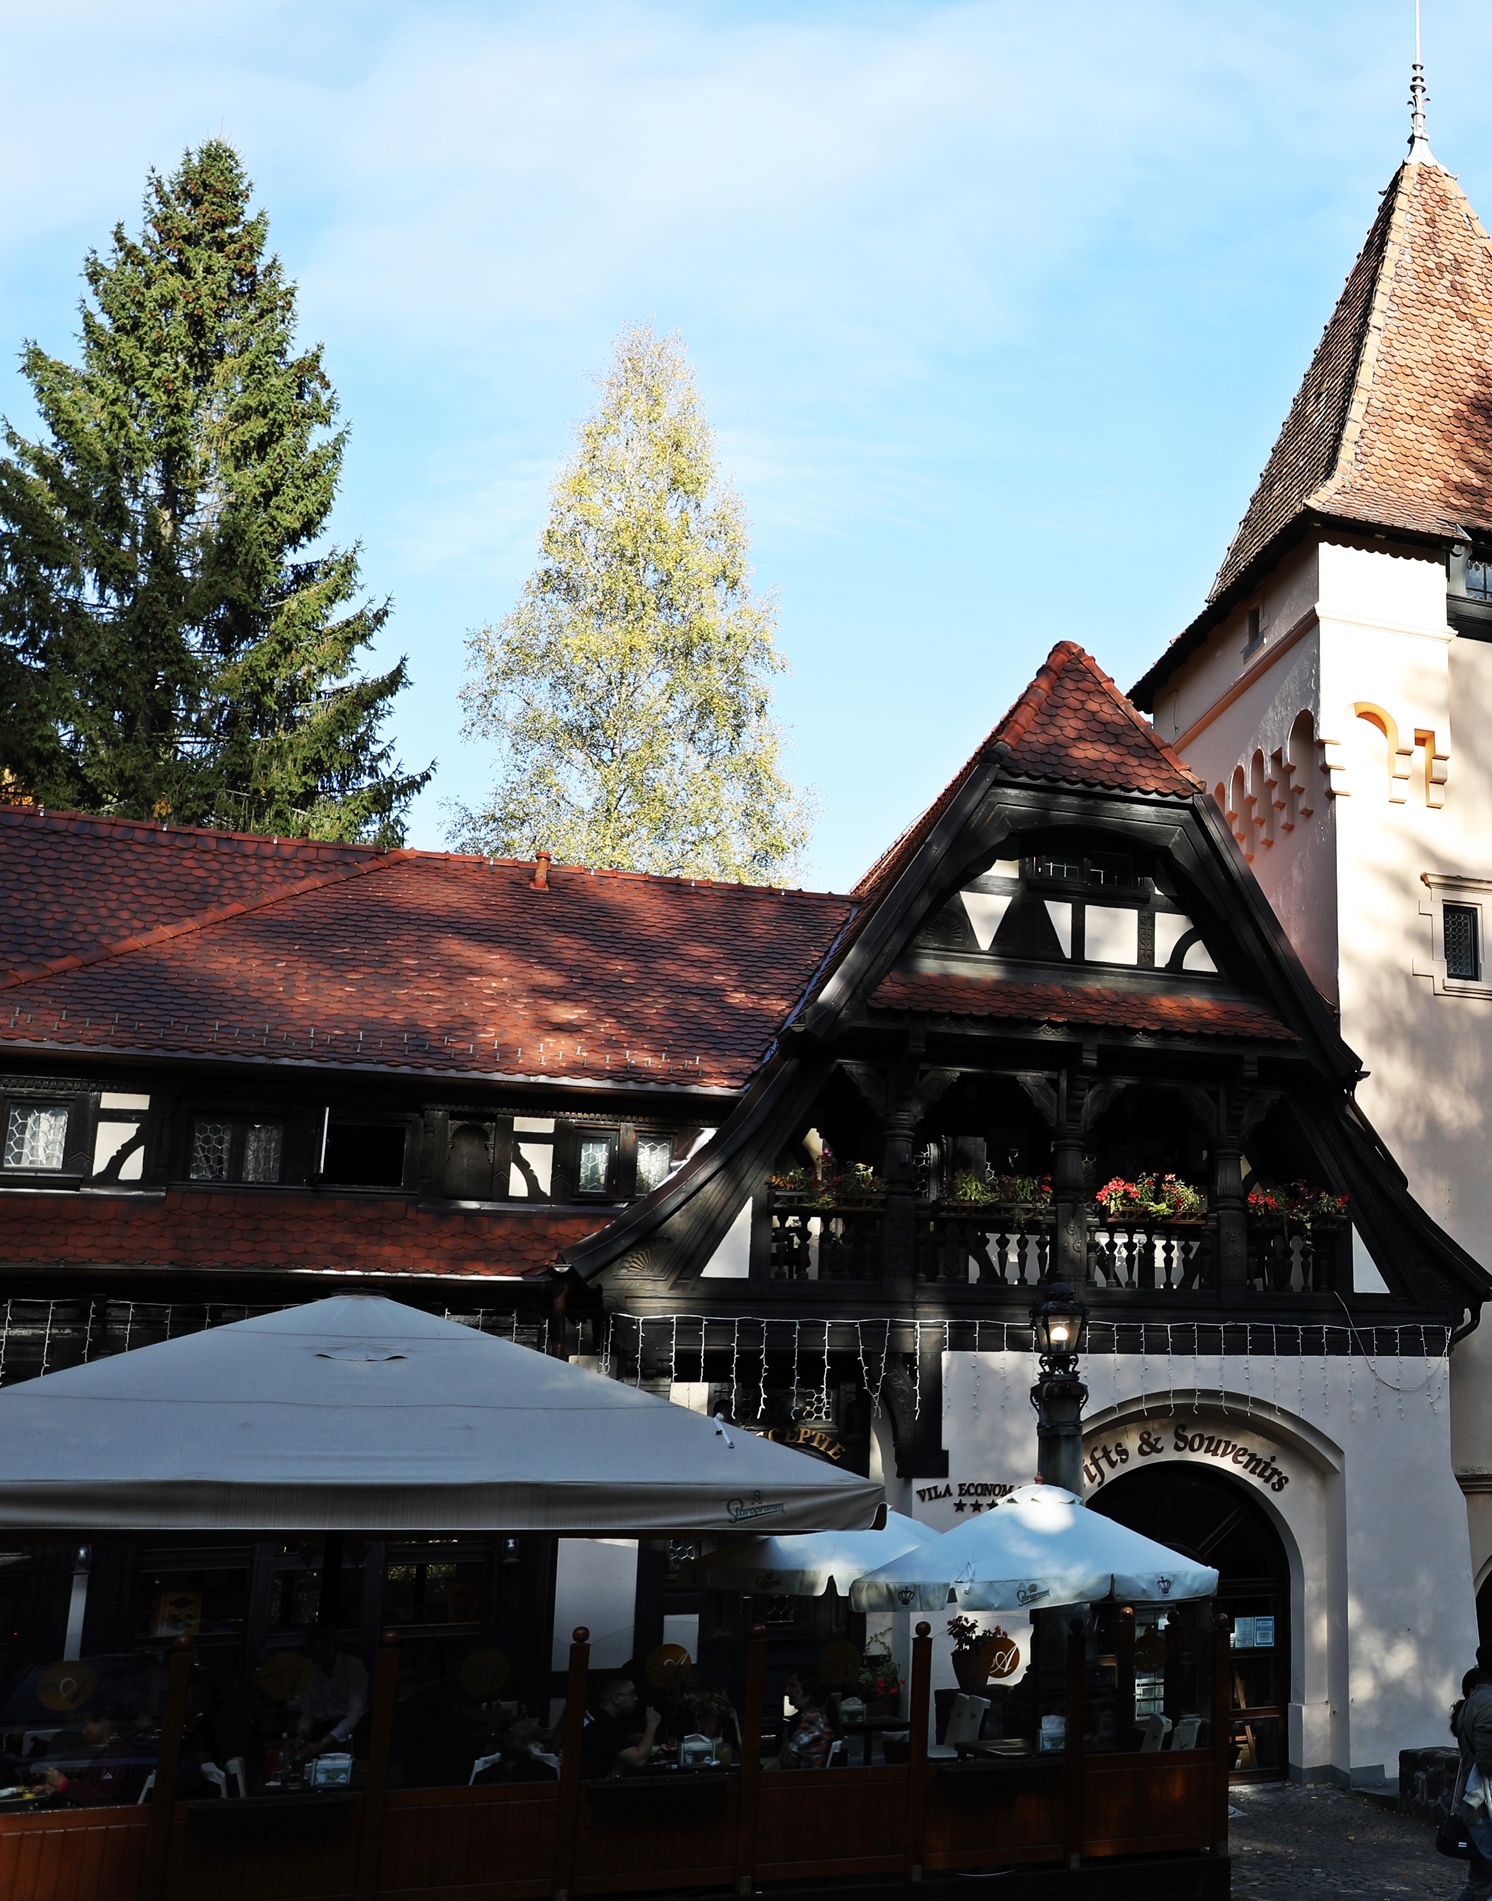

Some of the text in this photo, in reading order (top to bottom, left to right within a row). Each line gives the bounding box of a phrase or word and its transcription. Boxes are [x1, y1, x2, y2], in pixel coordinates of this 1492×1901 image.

[740, 1422, 847, 1461] CEPTIE
[1082, 1423, 1290, 1492] ifts & Souvenirs
[916, 1483, 953, 1502] VILA
[727, 1498, 786, 1524] Staropramen
